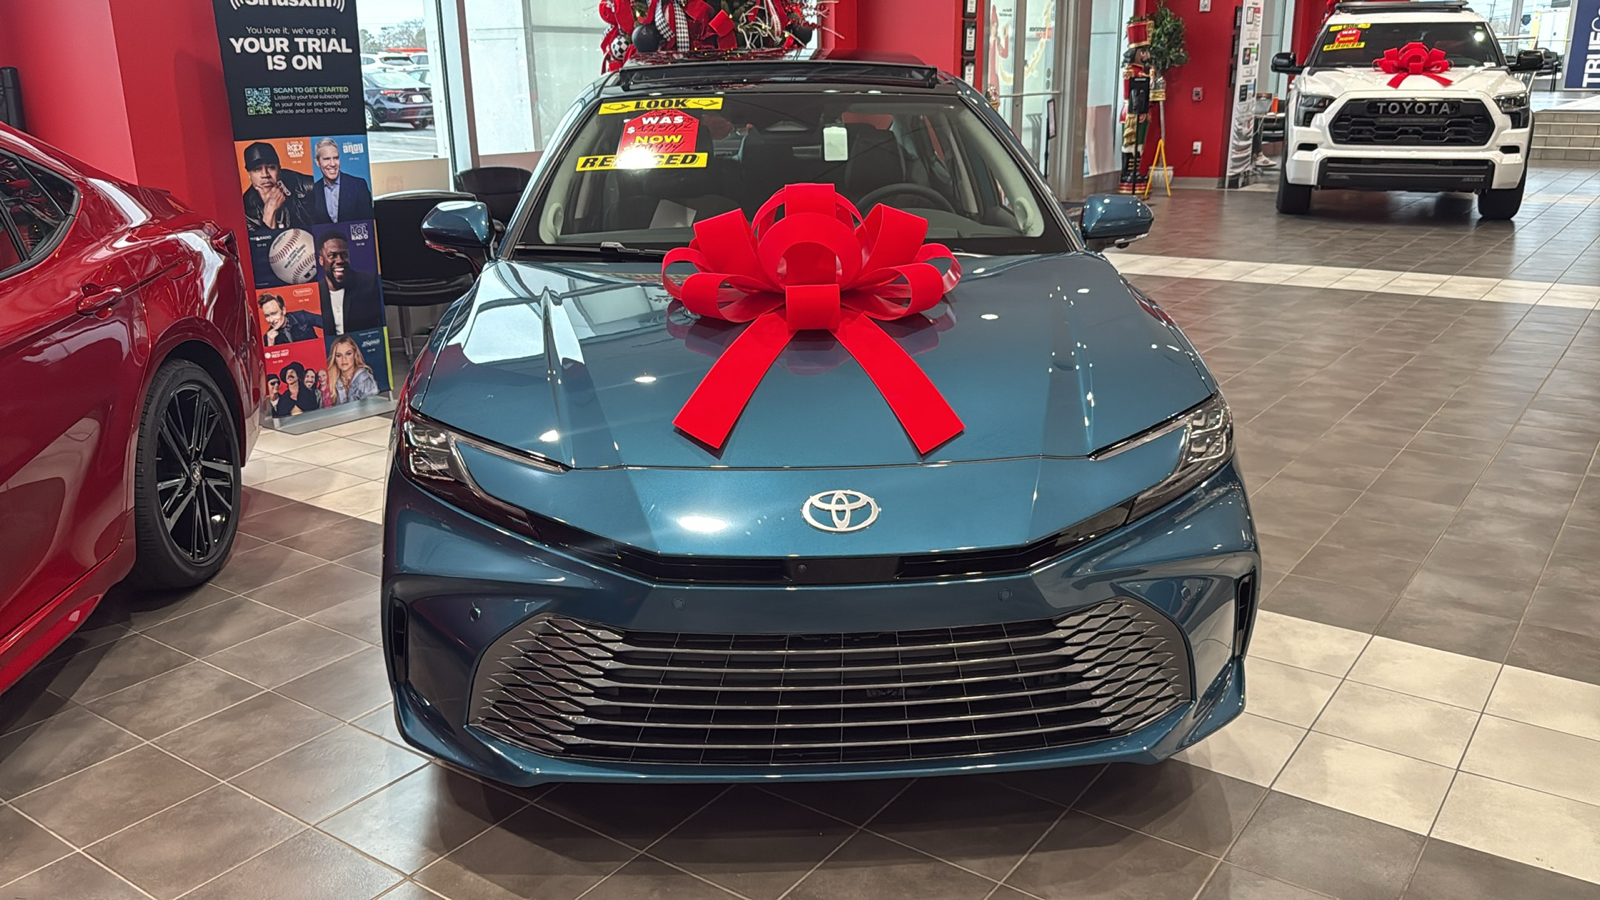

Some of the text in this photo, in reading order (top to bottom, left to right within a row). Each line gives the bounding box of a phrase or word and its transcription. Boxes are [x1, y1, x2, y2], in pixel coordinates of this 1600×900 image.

[246, 26, 336, 36] You love it, we've got it
[229, 37, 353, 54] YOUR TRIAL
[267, 55, 323, 71] IS ON
[634, 99, 690, 109] LOOK
[1376, 102, 1450, 115] TOYOTA
[641, 116, 684, 125] WAS
[627, 126, 636, 134] $
[634, 134, 683, 144] NOW
